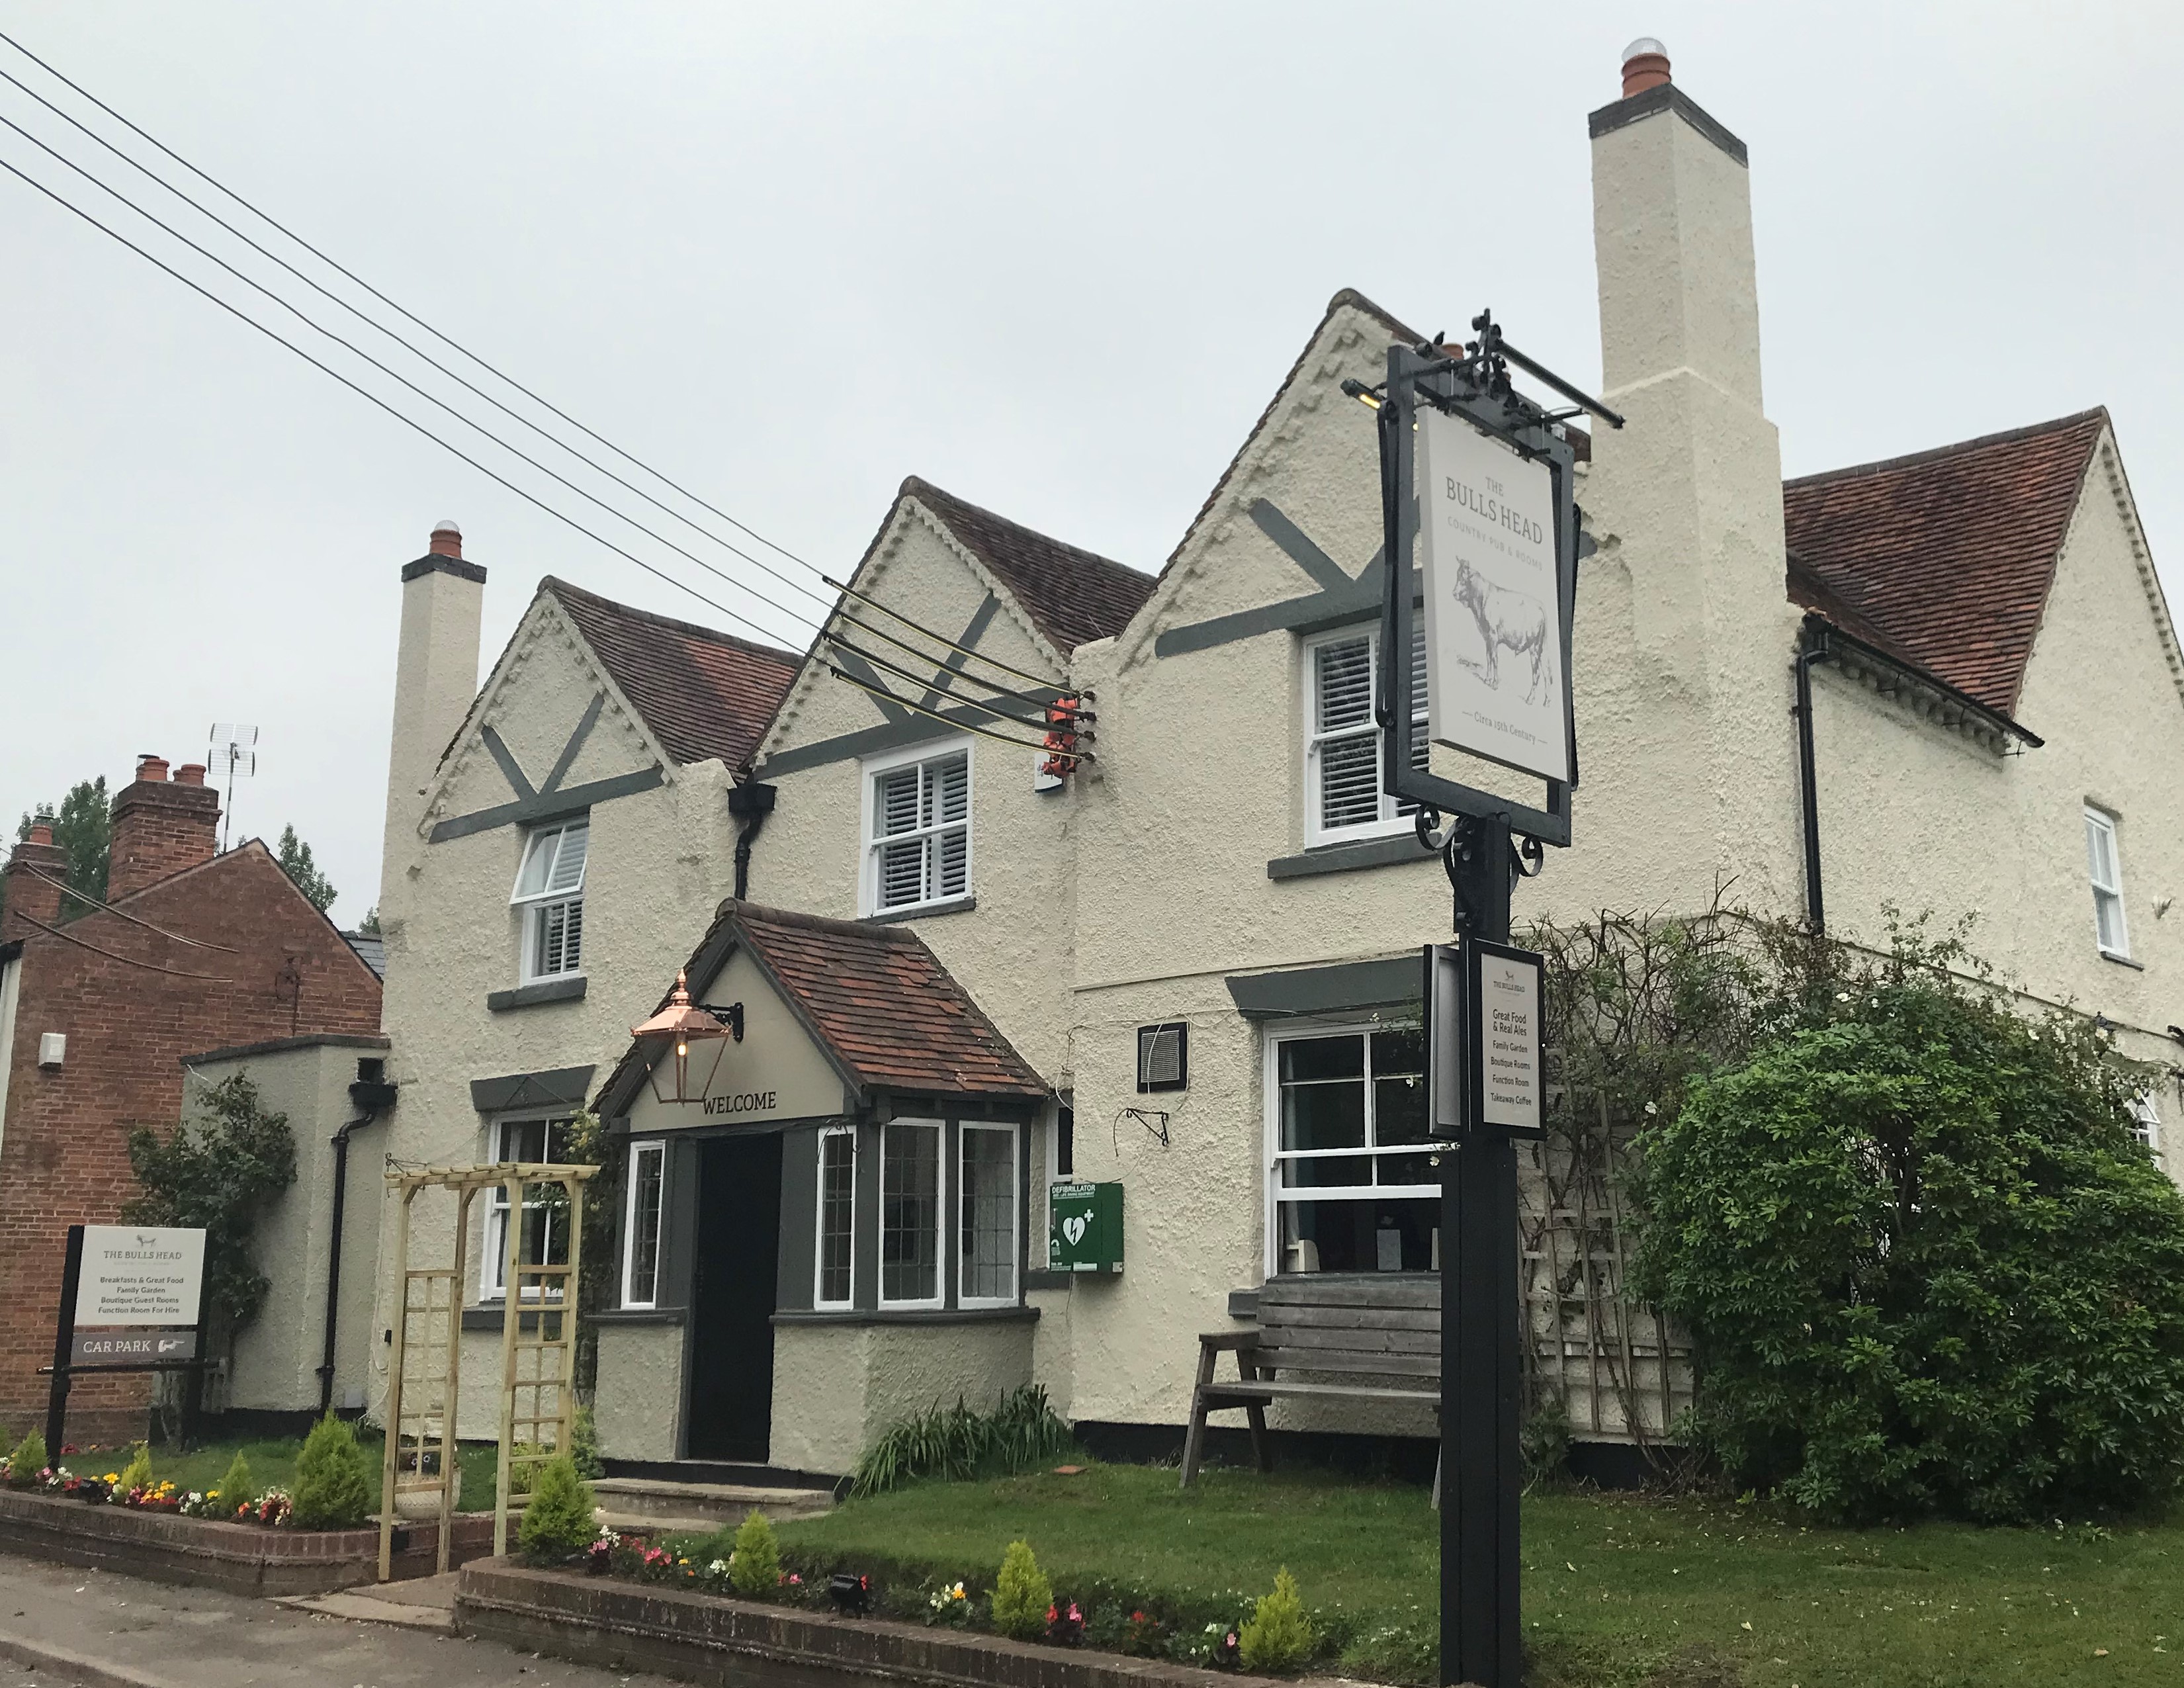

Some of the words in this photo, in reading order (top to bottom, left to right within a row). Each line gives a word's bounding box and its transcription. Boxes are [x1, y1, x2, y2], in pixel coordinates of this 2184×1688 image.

[1485, 476, 1504, 497] THE
[1446, 476, 1497, 521] BULLS
[1501, 504, 1542, 544] HEAD
[1448, 515, 1486, 543] COUNTRY
[1489, 536, 1505, 552] PUB
[1474, 711, 1493, 727] Circa
[1494, 720, 1508, 733] 15th
[1509, 725, 1536, 745] Century
[1493, 1009, 1510, 1021] Great
[1511, 1012, 1526, 1024] Food
[1493, 1021, 1498, 1032] &
[1500, 1022, 1512, 1034] Real
[1514, 1024, 1527, 1036] Ales
[1493, 1040, 1508, 1051] Family
[1510, 1043, 1528, 1053] Garden
[1491, 1057, 1513, 1068] Boutique
[1514, 1060, 1530, 1070] Rooms
[1493, 1074, 1514, 1085] Function
[1515, 1077, 1529, 1087] Room
[703, 1091, 777, 1115] WELCOME
[1491, 1092, 1514, 1105] Takeaway
[1516, 1096, 1532, 1106] Coffee
[1052, 1184, 1096, 1194] DEFIBRILLATOR
[125, 1251, 154, 1259] BULLS
[155, 1251, 182, 1260] HEAD
[83, 1339, 112, 1353] CAR
[115, 1339, 152, 1353] PARK
